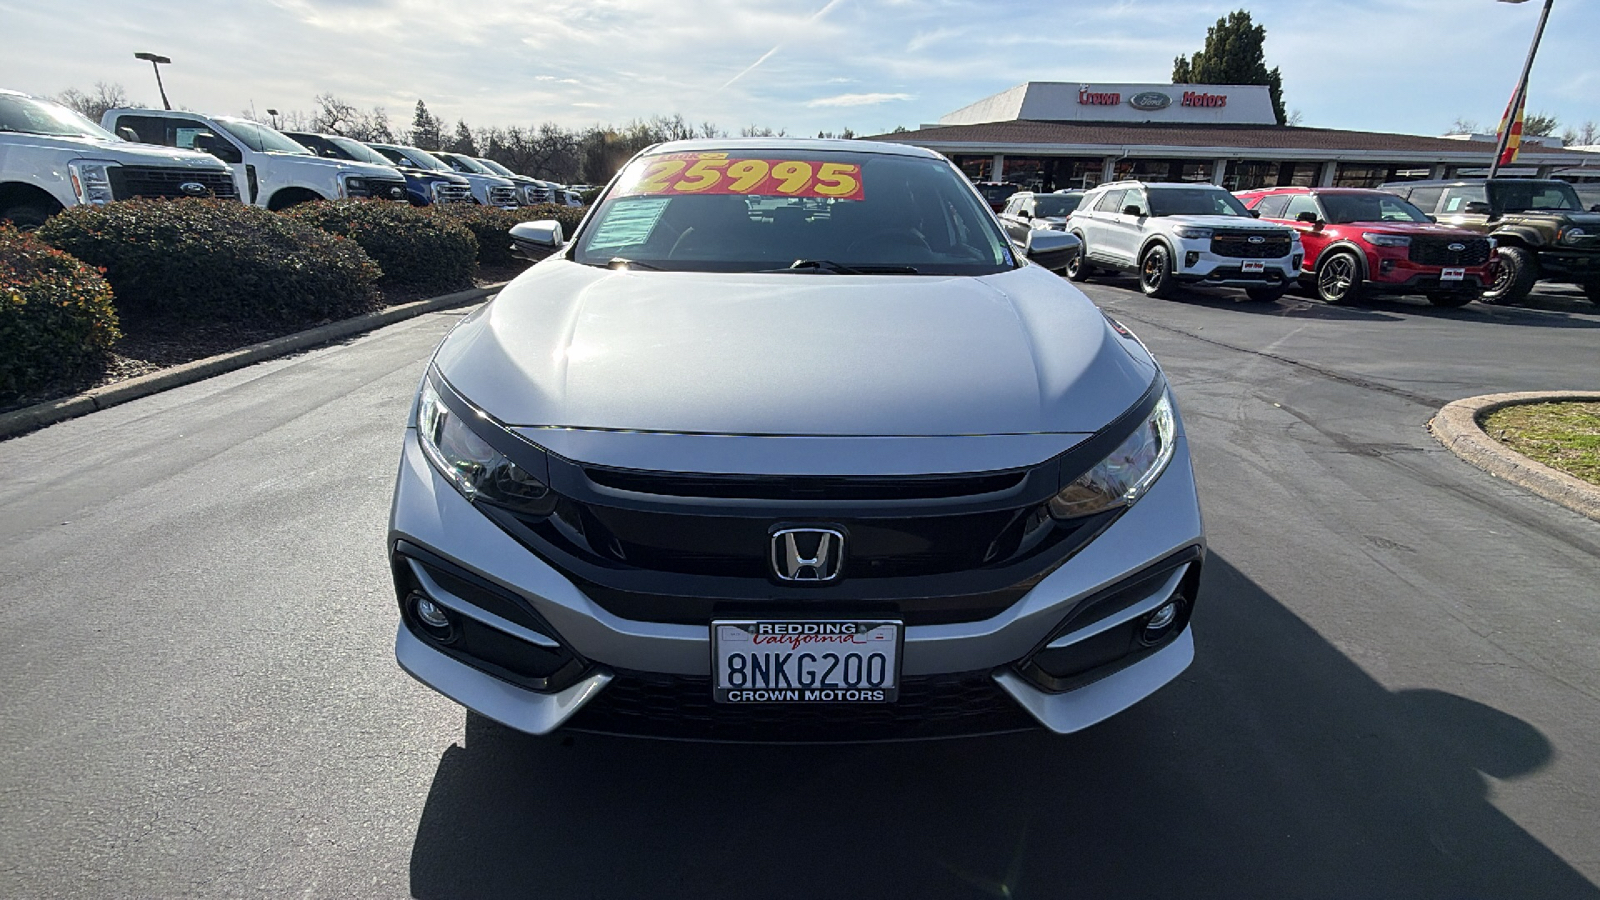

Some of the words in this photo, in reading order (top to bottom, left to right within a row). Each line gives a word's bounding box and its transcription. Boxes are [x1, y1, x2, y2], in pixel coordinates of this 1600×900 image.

[1079, 90, 1121, 105] Crown
[1139, 95, 1164, 106] Ford
[1182, 91, 1227, 107] Motors
[634, 159, 860, 198] 25995
[759, 623, 856, 634] REDDING
[753, 633, 867, 650] California
[727, 652, 887, 689] 8NKG200
[728, 690, 799, 702] CROWN
[805, 690, 884, 702] MOTORS
